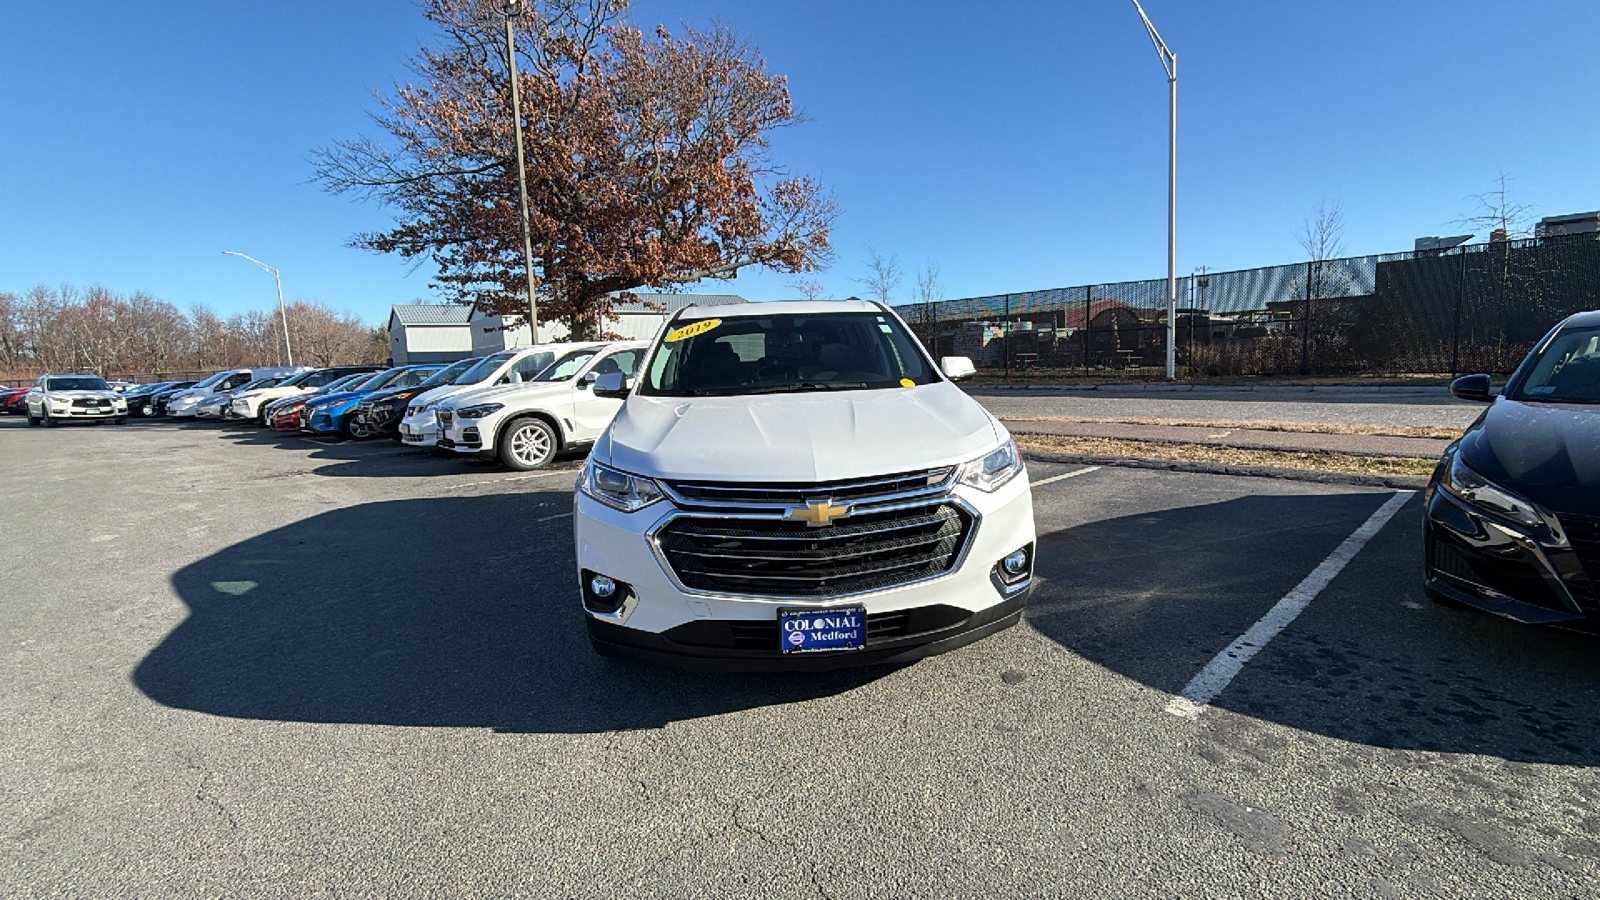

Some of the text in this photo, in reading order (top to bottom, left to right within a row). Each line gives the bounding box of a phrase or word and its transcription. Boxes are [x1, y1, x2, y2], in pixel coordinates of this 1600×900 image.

[677, 321, 711, 339] 2019
[784, 616, 861, 632] COLONIAL
[810, 630, 858, 641] Medford
